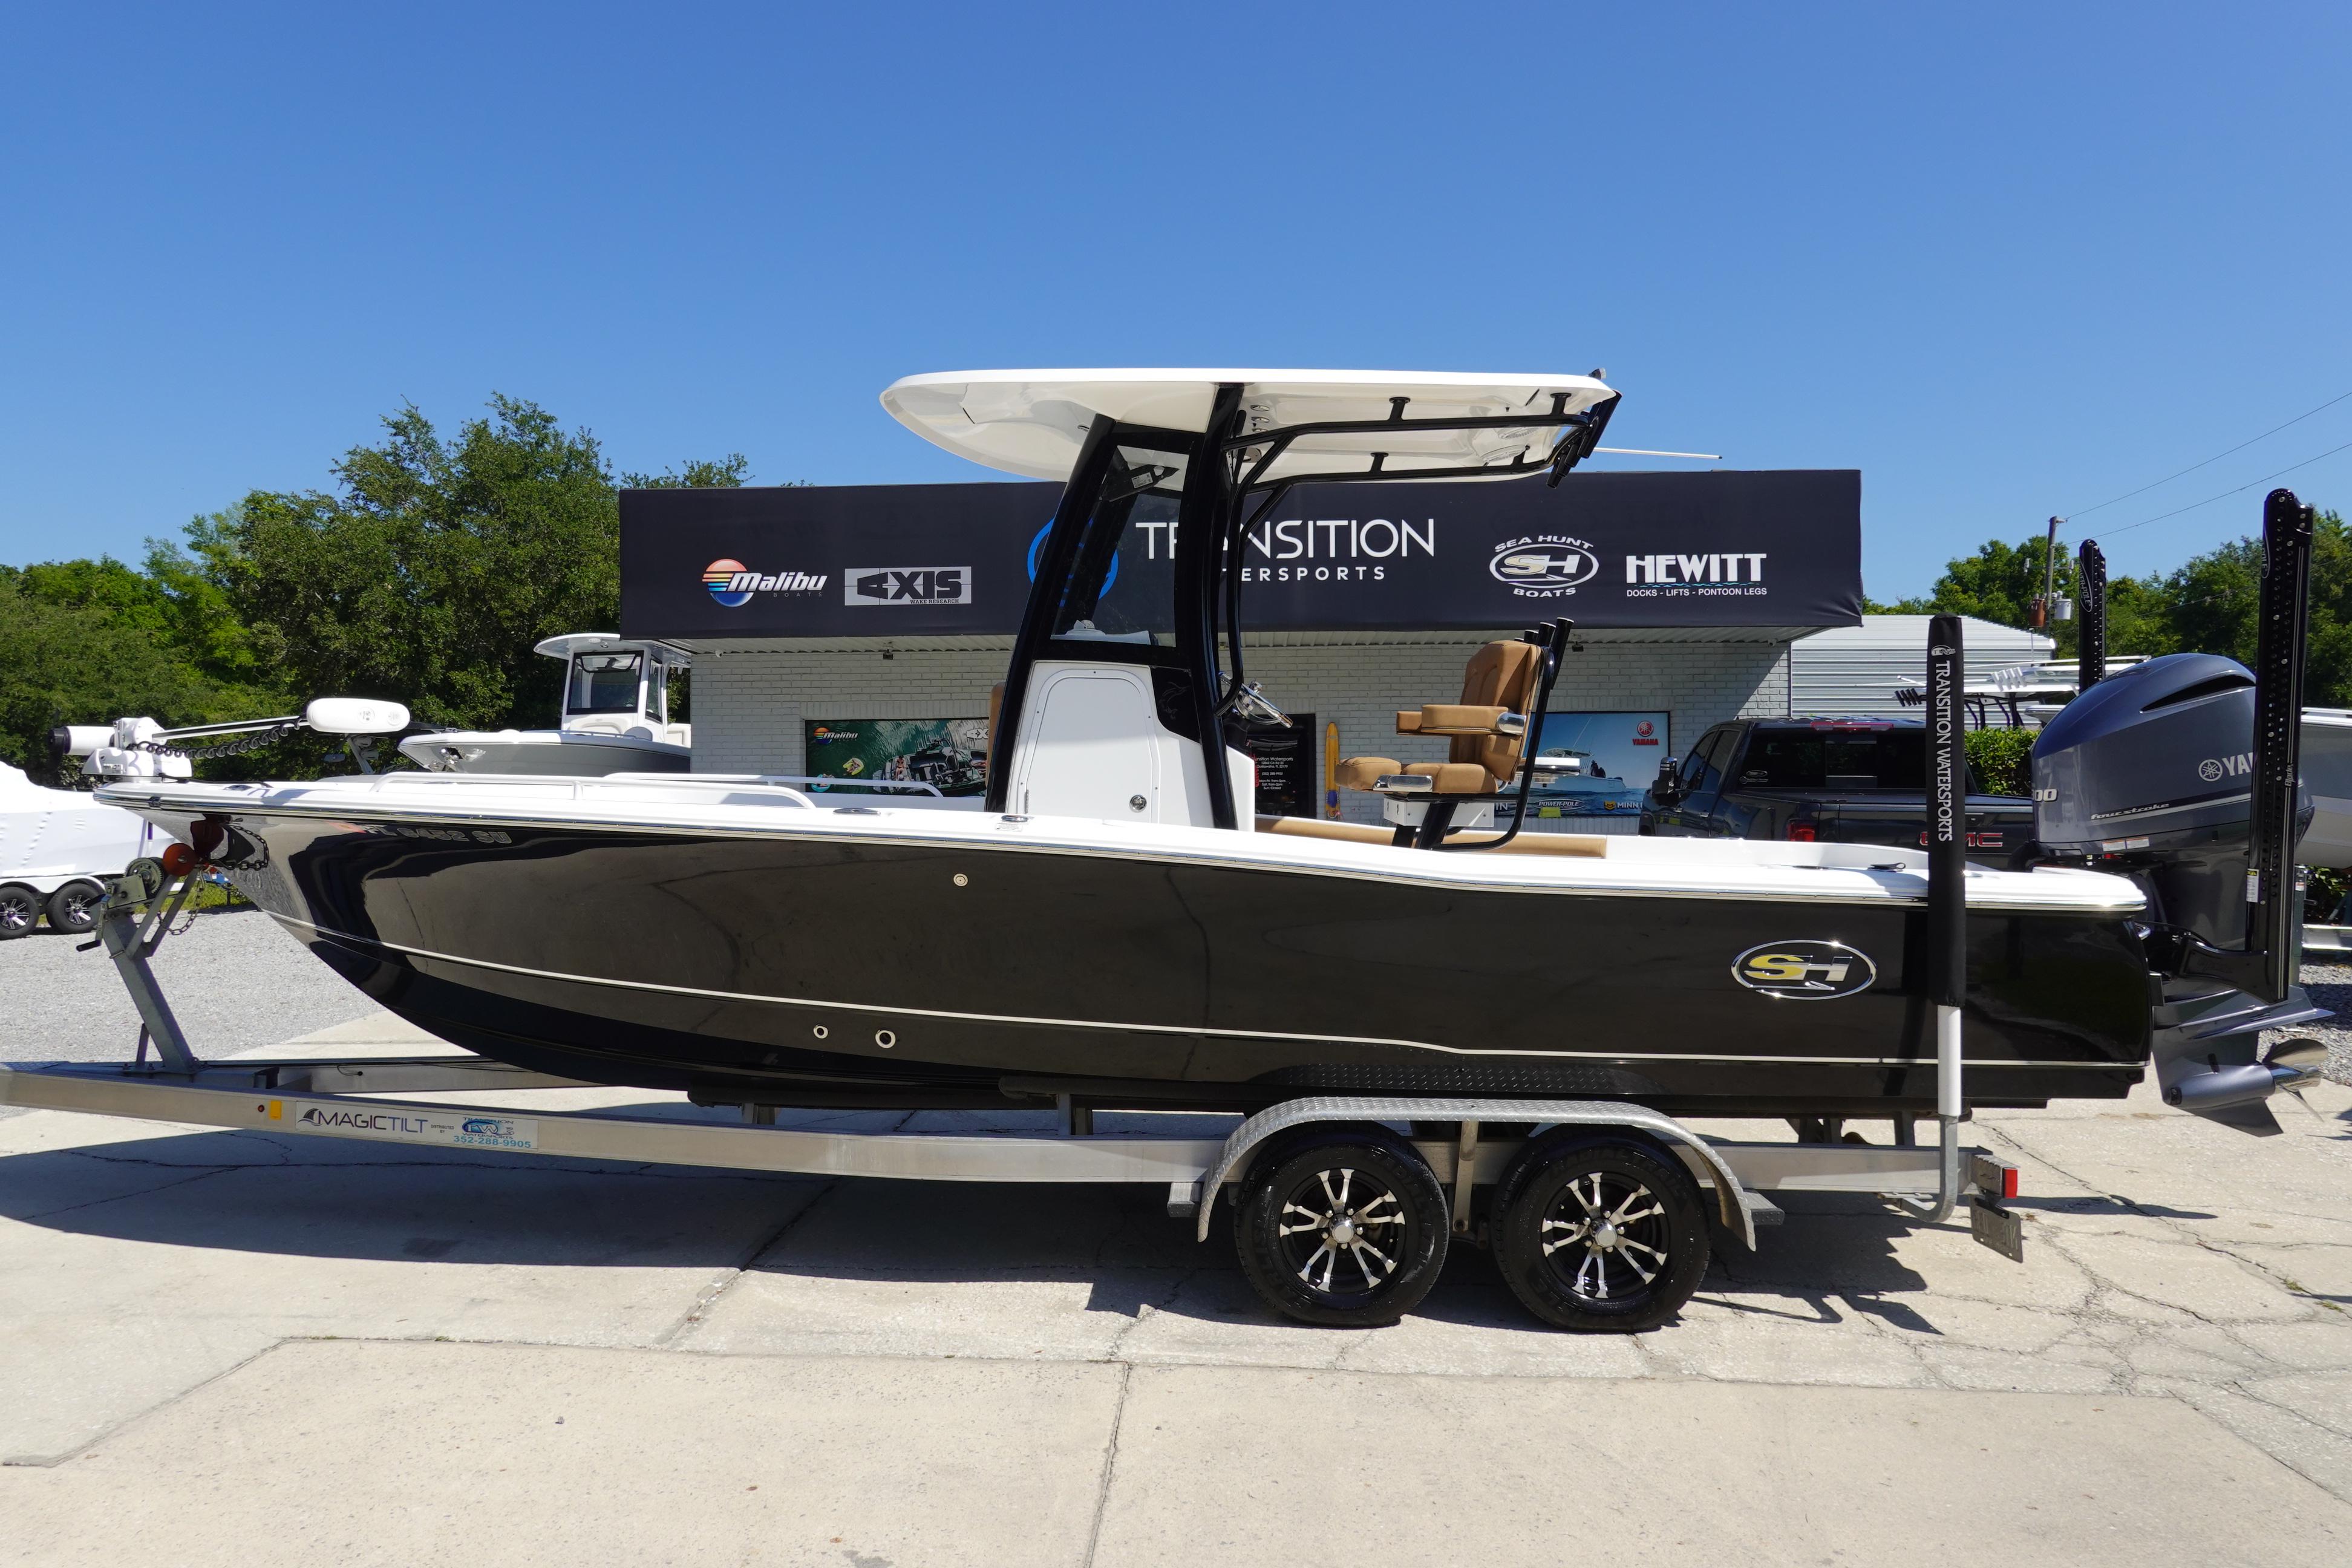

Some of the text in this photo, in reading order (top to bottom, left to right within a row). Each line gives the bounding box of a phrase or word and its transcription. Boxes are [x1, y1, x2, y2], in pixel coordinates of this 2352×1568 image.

[1135, 518, 1434, 559] TNSITION
[1494, 535, 1594, 552] SEA HUNT
[1222, 566, 1385, 581] ERSPORTS
[1500, 554, 1581, 575] SH
[1625, 553, 1767, 584] HEWITT
[727, 571, 828, 592] Malibu
[857, 570, 962, 600] AXIS
[1513, 587, 1576, 598] BOATS
[1626, 589, 1658, 597] DOCKS
[1697, 588, 1742, 596] PONTOON
[1936, 660, 1952, 744] TRANSITION
[966, 728, 989, 739] AX
[1936, 748, 1953, 842] WATERSPORTS
[2032, 788, 2057, 802] 00
[2091, 803, 2171, 820] fourstroke
[318, 1112, 428, 1134] MAGICTILT
[454, 1135, 532, 1149] 352-288-9905
